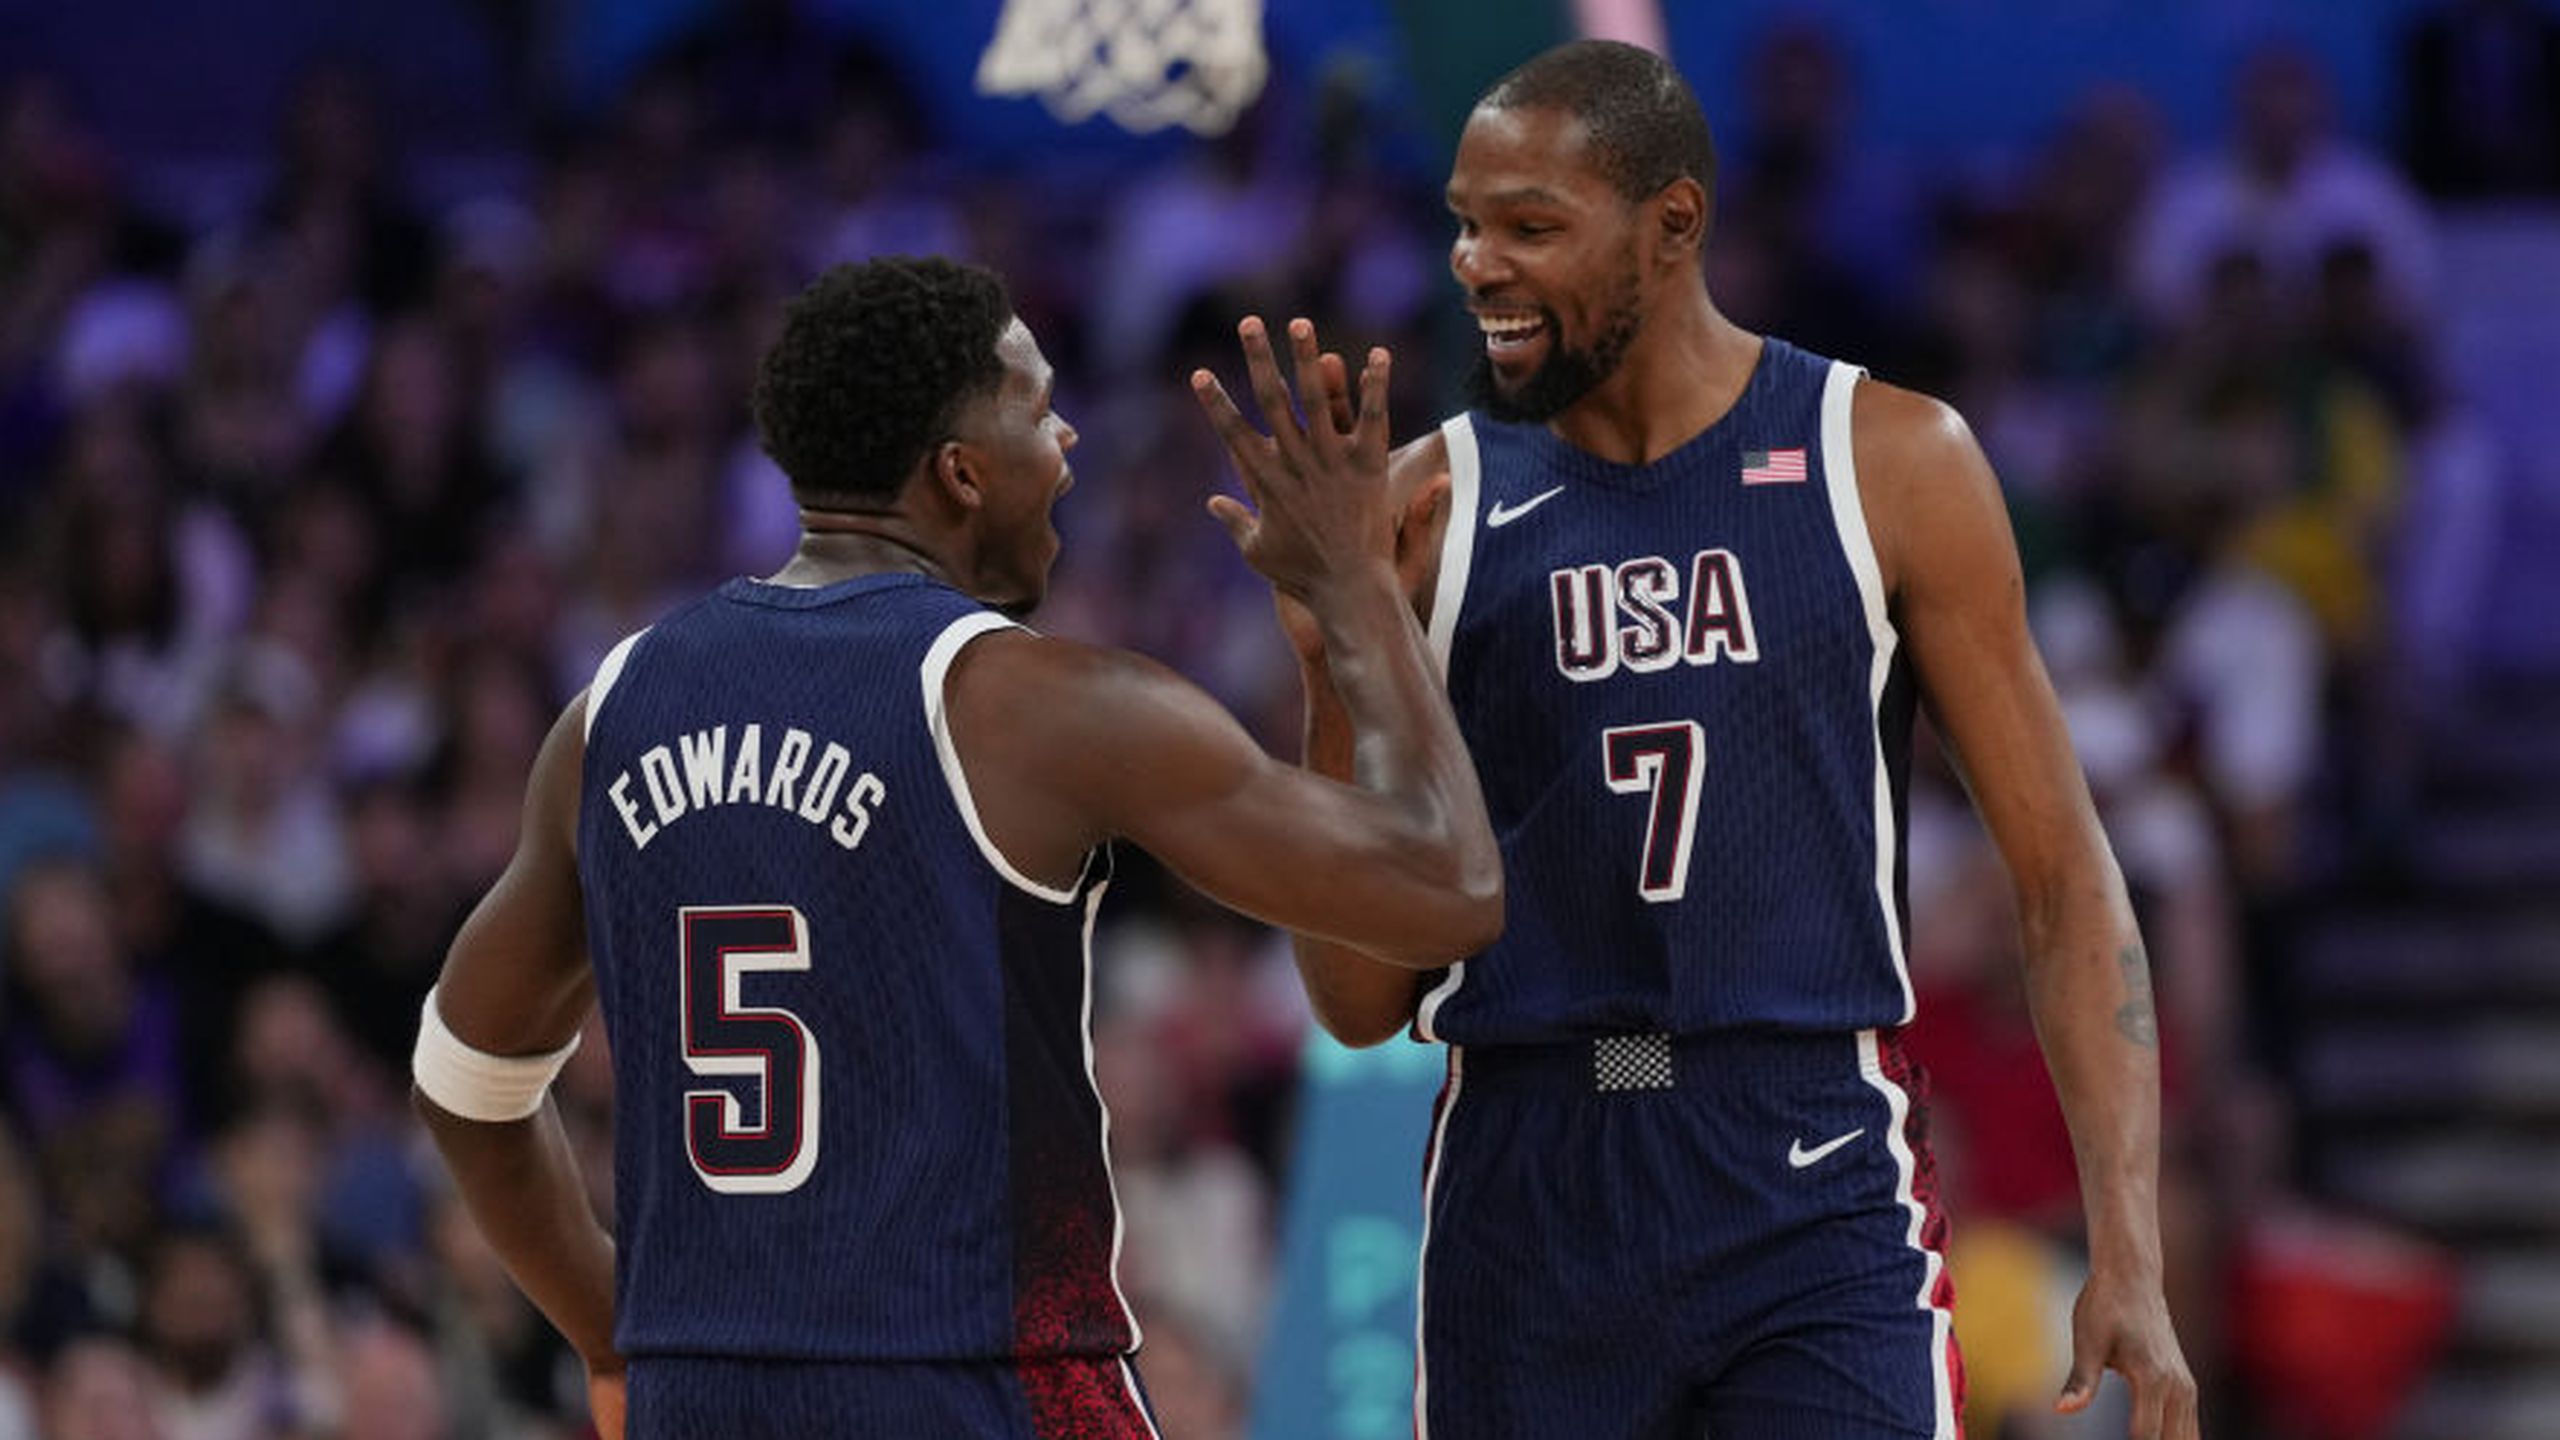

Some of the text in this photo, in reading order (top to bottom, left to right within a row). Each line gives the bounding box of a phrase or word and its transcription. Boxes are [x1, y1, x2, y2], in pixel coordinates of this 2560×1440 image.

[1550, 549, 1759, 682] USA
[608, 724, 885, 849] EDWARDS
[1603, 721, 1705, 902] 7
[678, 905, 821, 1194] 5
